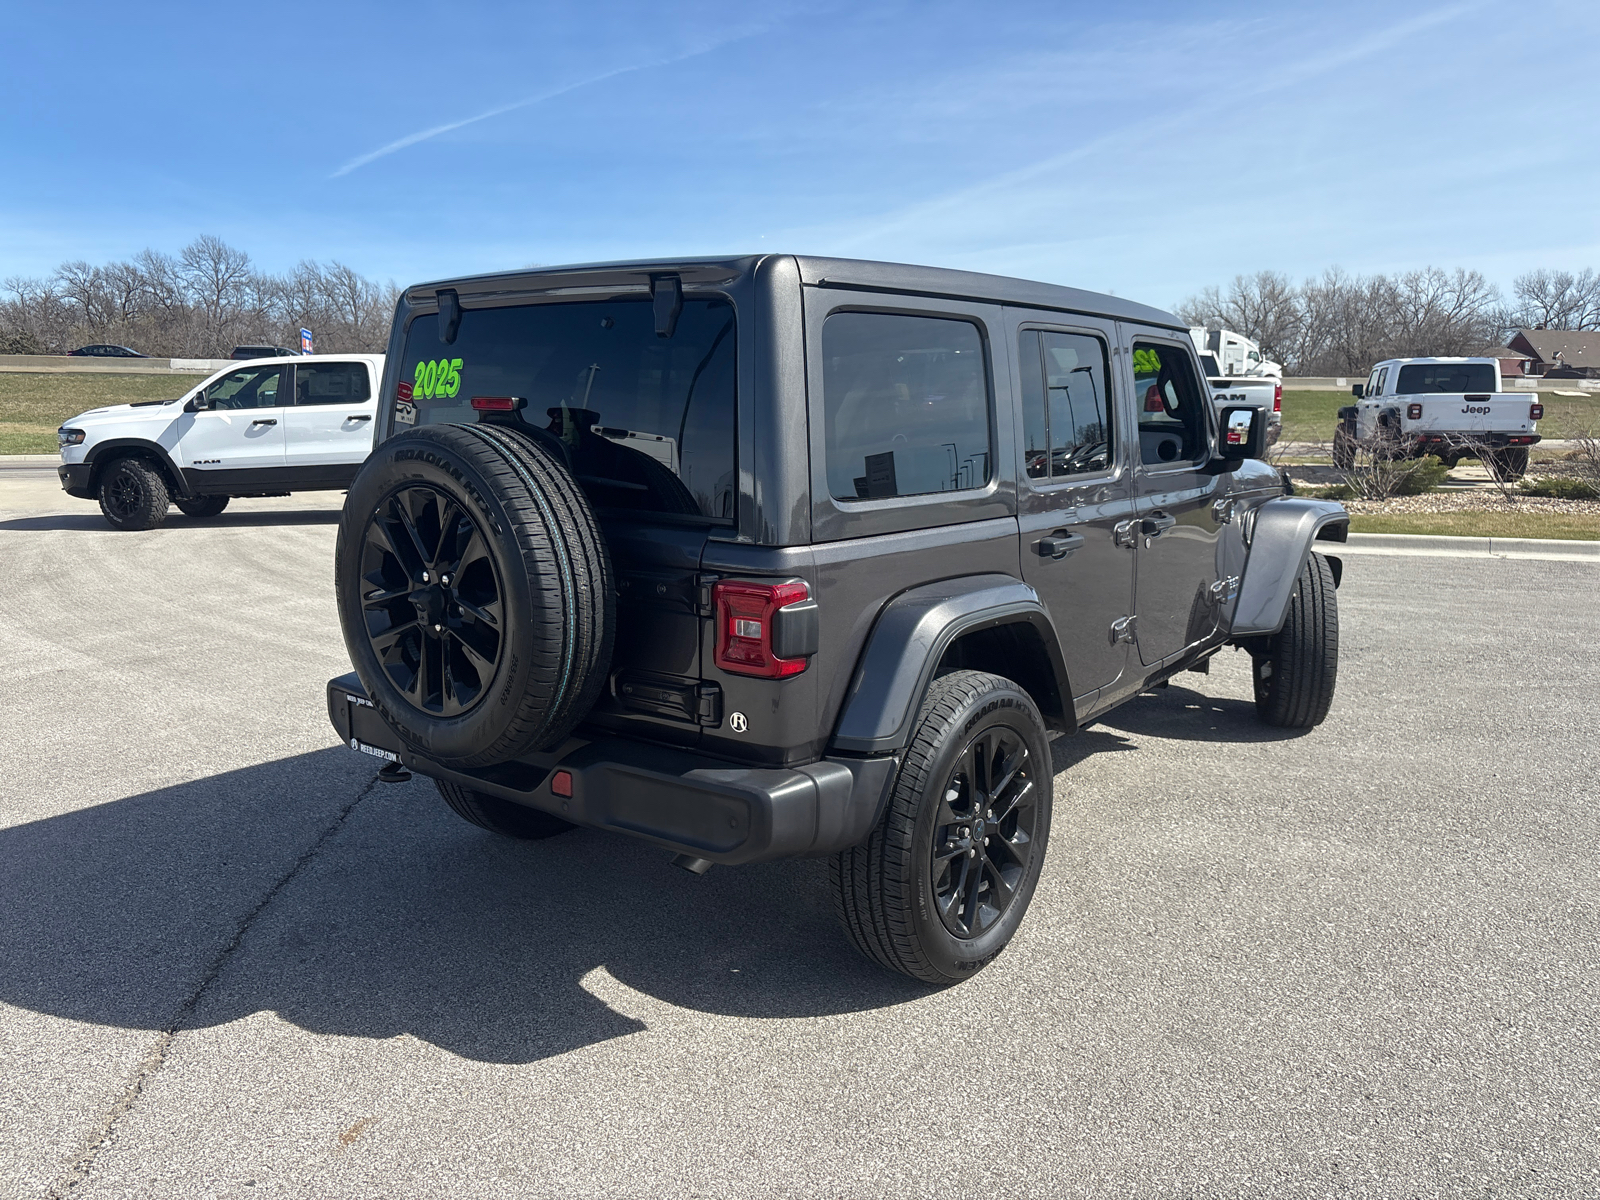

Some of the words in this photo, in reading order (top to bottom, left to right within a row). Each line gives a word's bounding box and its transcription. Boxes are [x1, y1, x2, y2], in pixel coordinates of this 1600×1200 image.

[412, 358, 463, 400] 2025
[1461, 405, 1491, 415] Jeep
[394, 448, 464, 481] ROADIAN
[964, 698, 1014, 735] ROADIAN
[360, 743, 397, 762] REEDJEEP.COM
